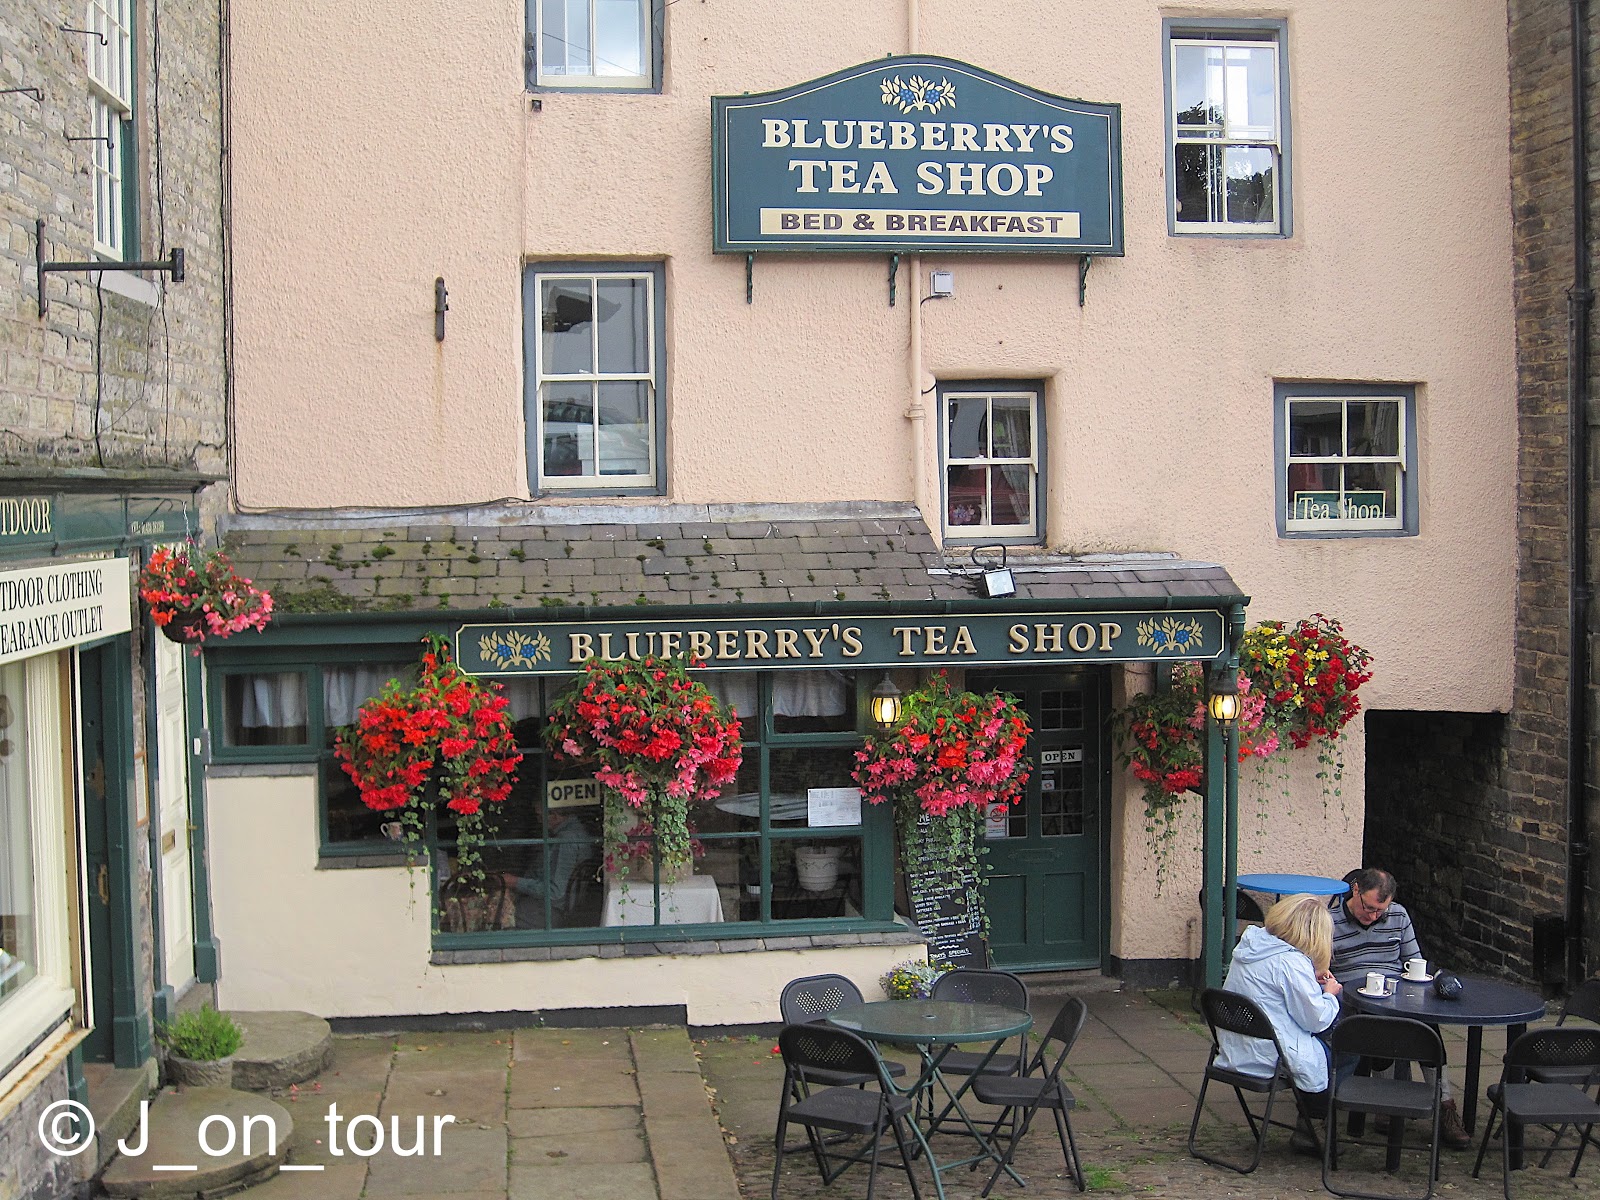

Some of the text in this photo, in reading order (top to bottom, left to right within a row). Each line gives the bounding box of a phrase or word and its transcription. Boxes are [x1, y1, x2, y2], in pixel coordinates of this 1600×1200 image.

[762, 118, 1074, 154] BLUEBERRY'S
[788, 159, 1054, 197] TEA SHOP
[781, 213, 1064, 234] BED & BREAKFAST
[1299, 497, 1331, 519] Tea
[47, 568, 103, 604] CLOTHING
[0, 605, 104, 655] EARANCE OUTLET
[569, 622, 1122, 663] BLUEBERRY'S TEA SHOP
[1044, 752, 1075, 761] OPEN
[551, 783, 596, 801] OPEN
